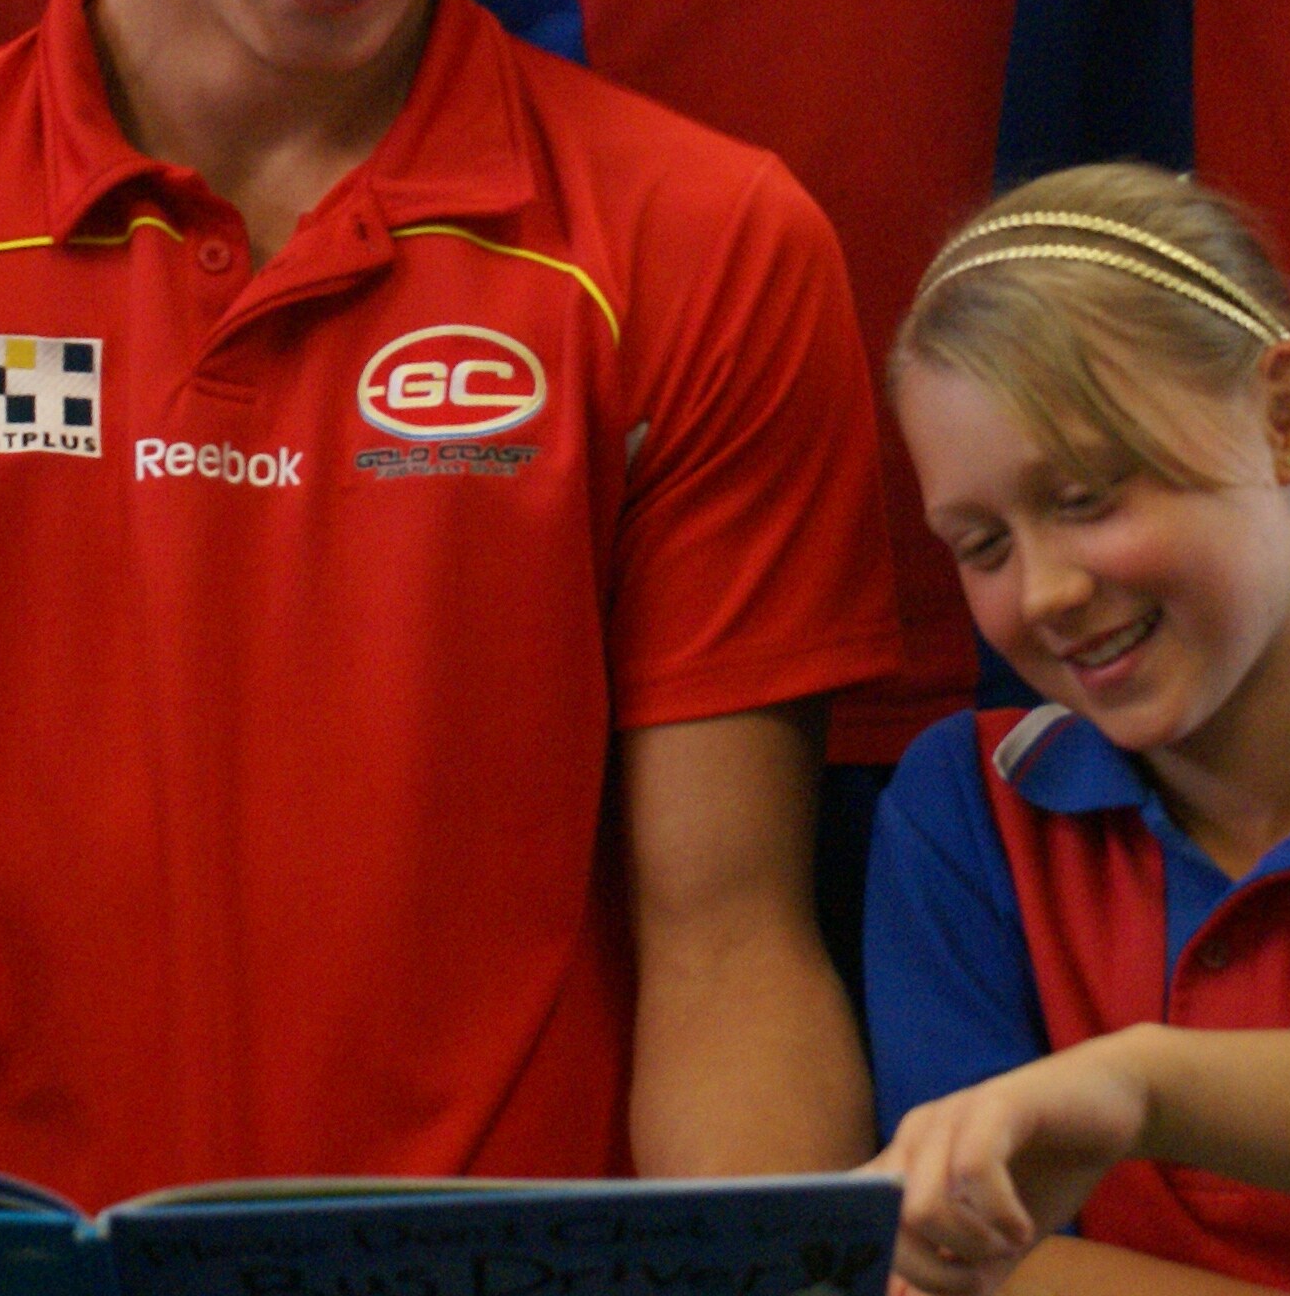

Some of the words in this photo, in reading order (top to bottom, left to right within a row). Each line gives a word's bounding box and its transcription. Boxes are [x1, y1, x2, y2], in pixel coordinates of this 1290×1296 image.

[386, 359, 519, 410] GC
[134, 437, 304, 487] Reebok
[355, 446, 430, 469] GOLD
[437, 444, 540, 464] COAST
[472, 1254, 787, 1296] Driver
